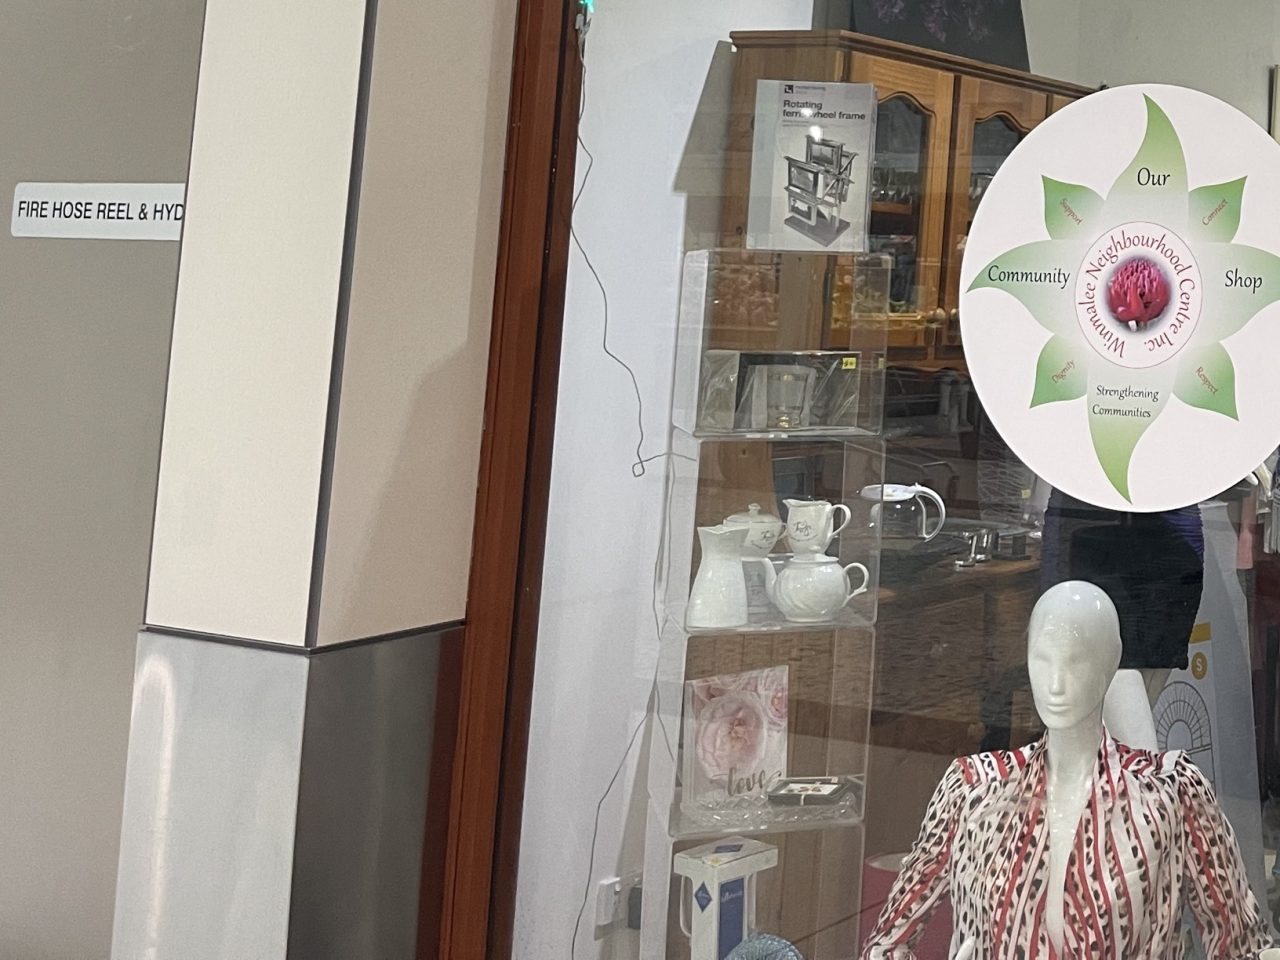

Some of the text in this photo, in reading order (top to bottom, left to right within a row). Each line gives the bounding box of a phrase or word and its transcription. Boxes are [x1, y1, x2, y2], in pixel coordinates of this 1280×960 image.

[784, 100, 823, 110] Rotating
[839, 112, 866, 120] frame
[1137, 168, 1170, 187] Our
[18, 201, 184, 221] FIRE HOSE REEL & HYD
[1060, 198, 1083, 225] Support
[1202, 199, 1228, 225] Connect
[988, 265, 1071, 289] Community
[1225, 269, 1263, 294] Shop
[1078, 230, 1196, 358] Winmalee Neighbourhood Centre Inc.
[1196, 366, 1218, 395] Respect
[1096, 385, 1159, 402] Strengthening
[1093, 404, 1151, 417] Communities
